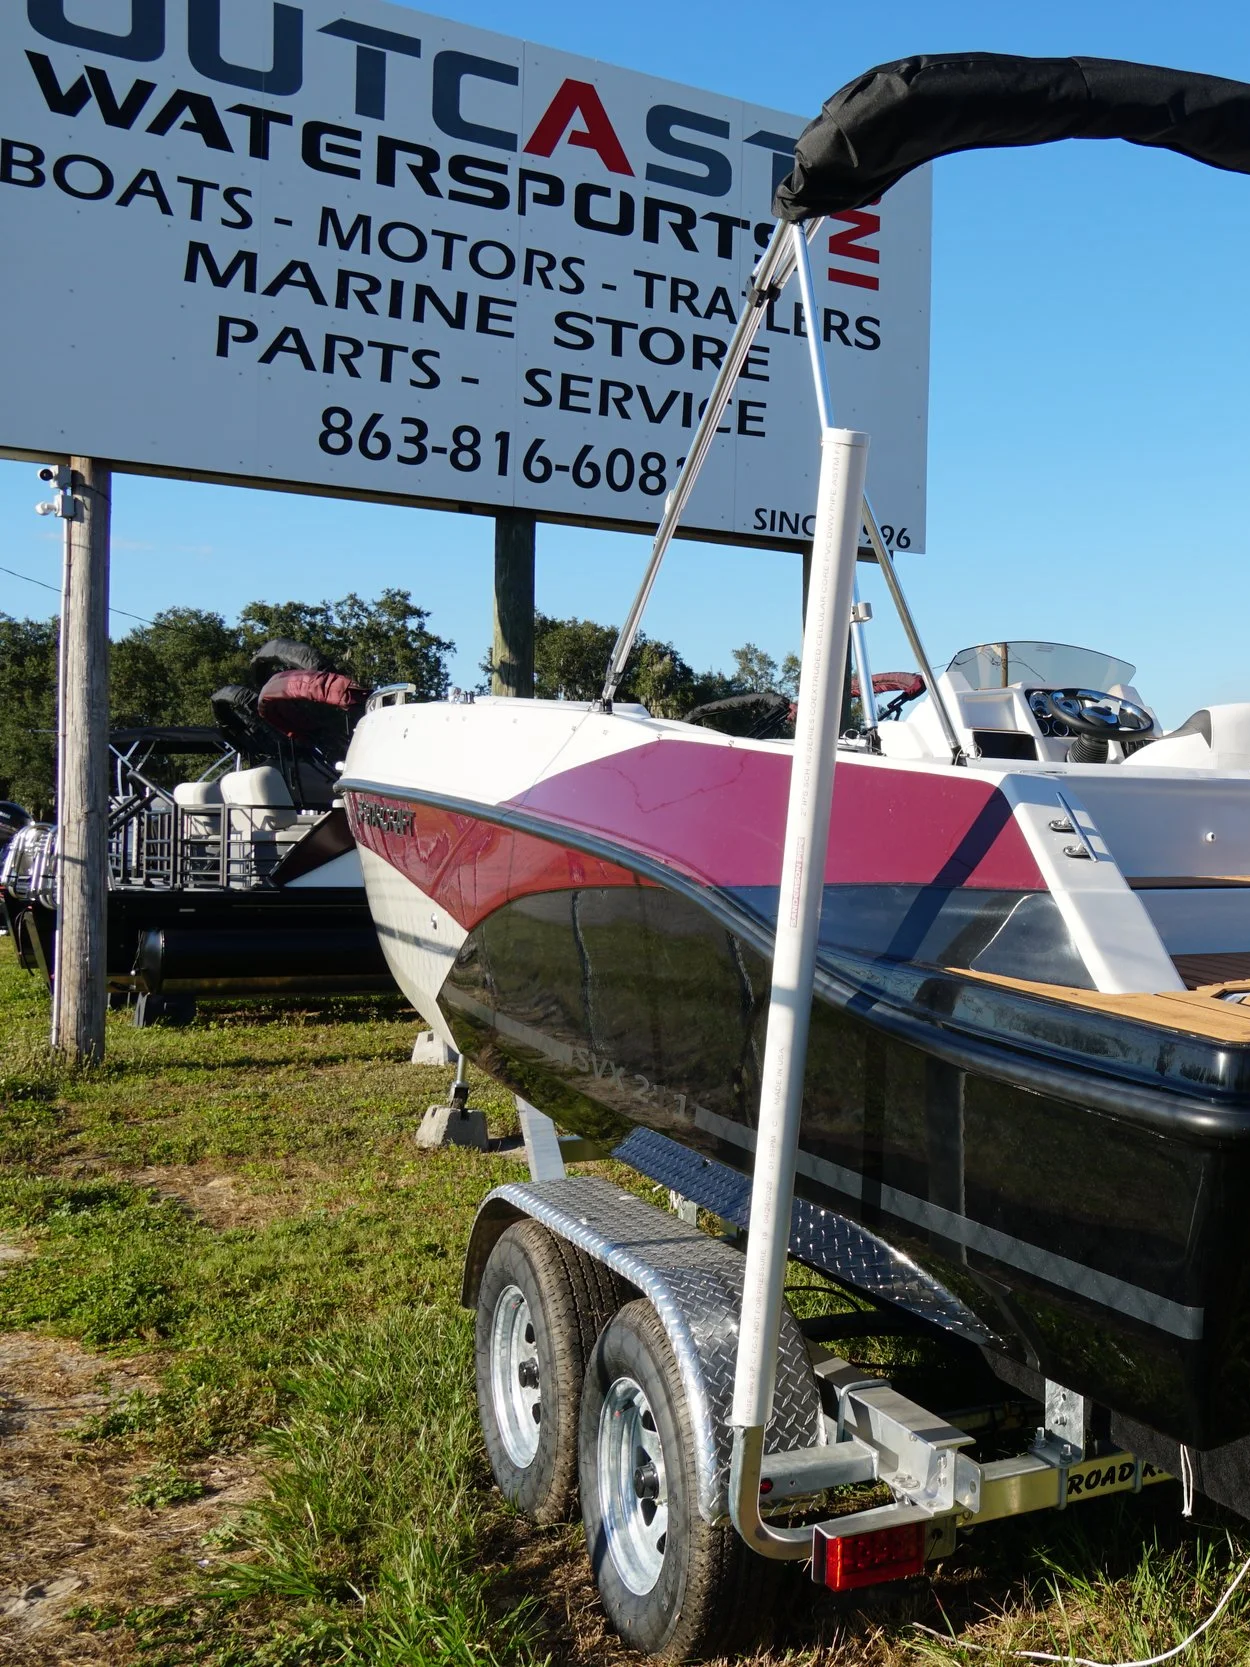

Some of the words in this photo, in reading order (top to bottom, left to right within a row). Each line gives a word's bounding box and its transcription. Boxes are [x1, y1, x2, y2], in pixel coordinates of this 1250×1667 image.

[1, 138, 253, 230] BOATS
[318, 206, 585, 294] MOTORS
[634, 269, 881, 350] TRALERS
[828, 193, 881, 291] IN
[184, 241, 517, 339] MARINE
[553, 311, 770, 382] STORE
[216, 315, 441, 390] PARTS
[318, 406, 687, 496] 863-816-608
[831, 457, 840, 487] ASTM
[753, 508, 816, 536] SINC
[826, 514, 835, 539] DWV
[824, 540, 832, 562] PVC
[821, 565, 830, 593] CORE
[817, 595, 827, 646] CELLULAR
[810, 648, 822, 716] COEXTRUDED
[807, 718, 815, 752] SERIES
[796, 836, 805, 861] PIPE
[790, 863, 803, 926] SANDERSON
[757, 1248, 767, 1294] PRESSURE
[774, 1078, 782, 1105] MADE
[1067, 1462, 1136, 1495] ROAD
